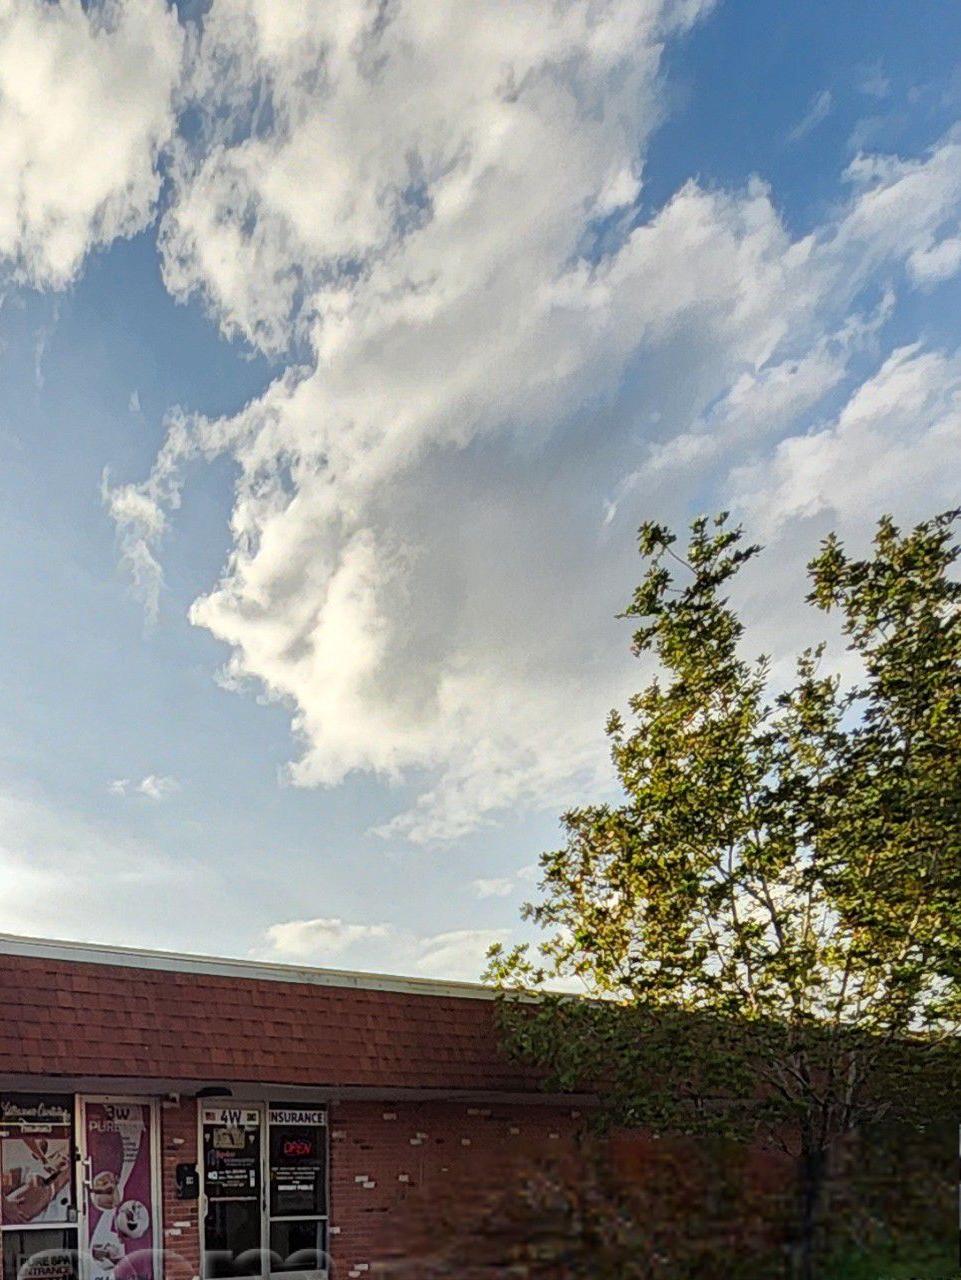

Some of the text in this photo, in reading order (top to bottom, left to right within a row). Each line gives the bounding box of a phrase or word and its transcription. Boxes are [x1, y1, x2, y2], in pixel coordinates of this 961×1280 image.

[220, 1109, 242, 1124] 4W
[284, 1140, 311, 1154] OPEN
[22, 1266, 71, 1277] NTRANCE
